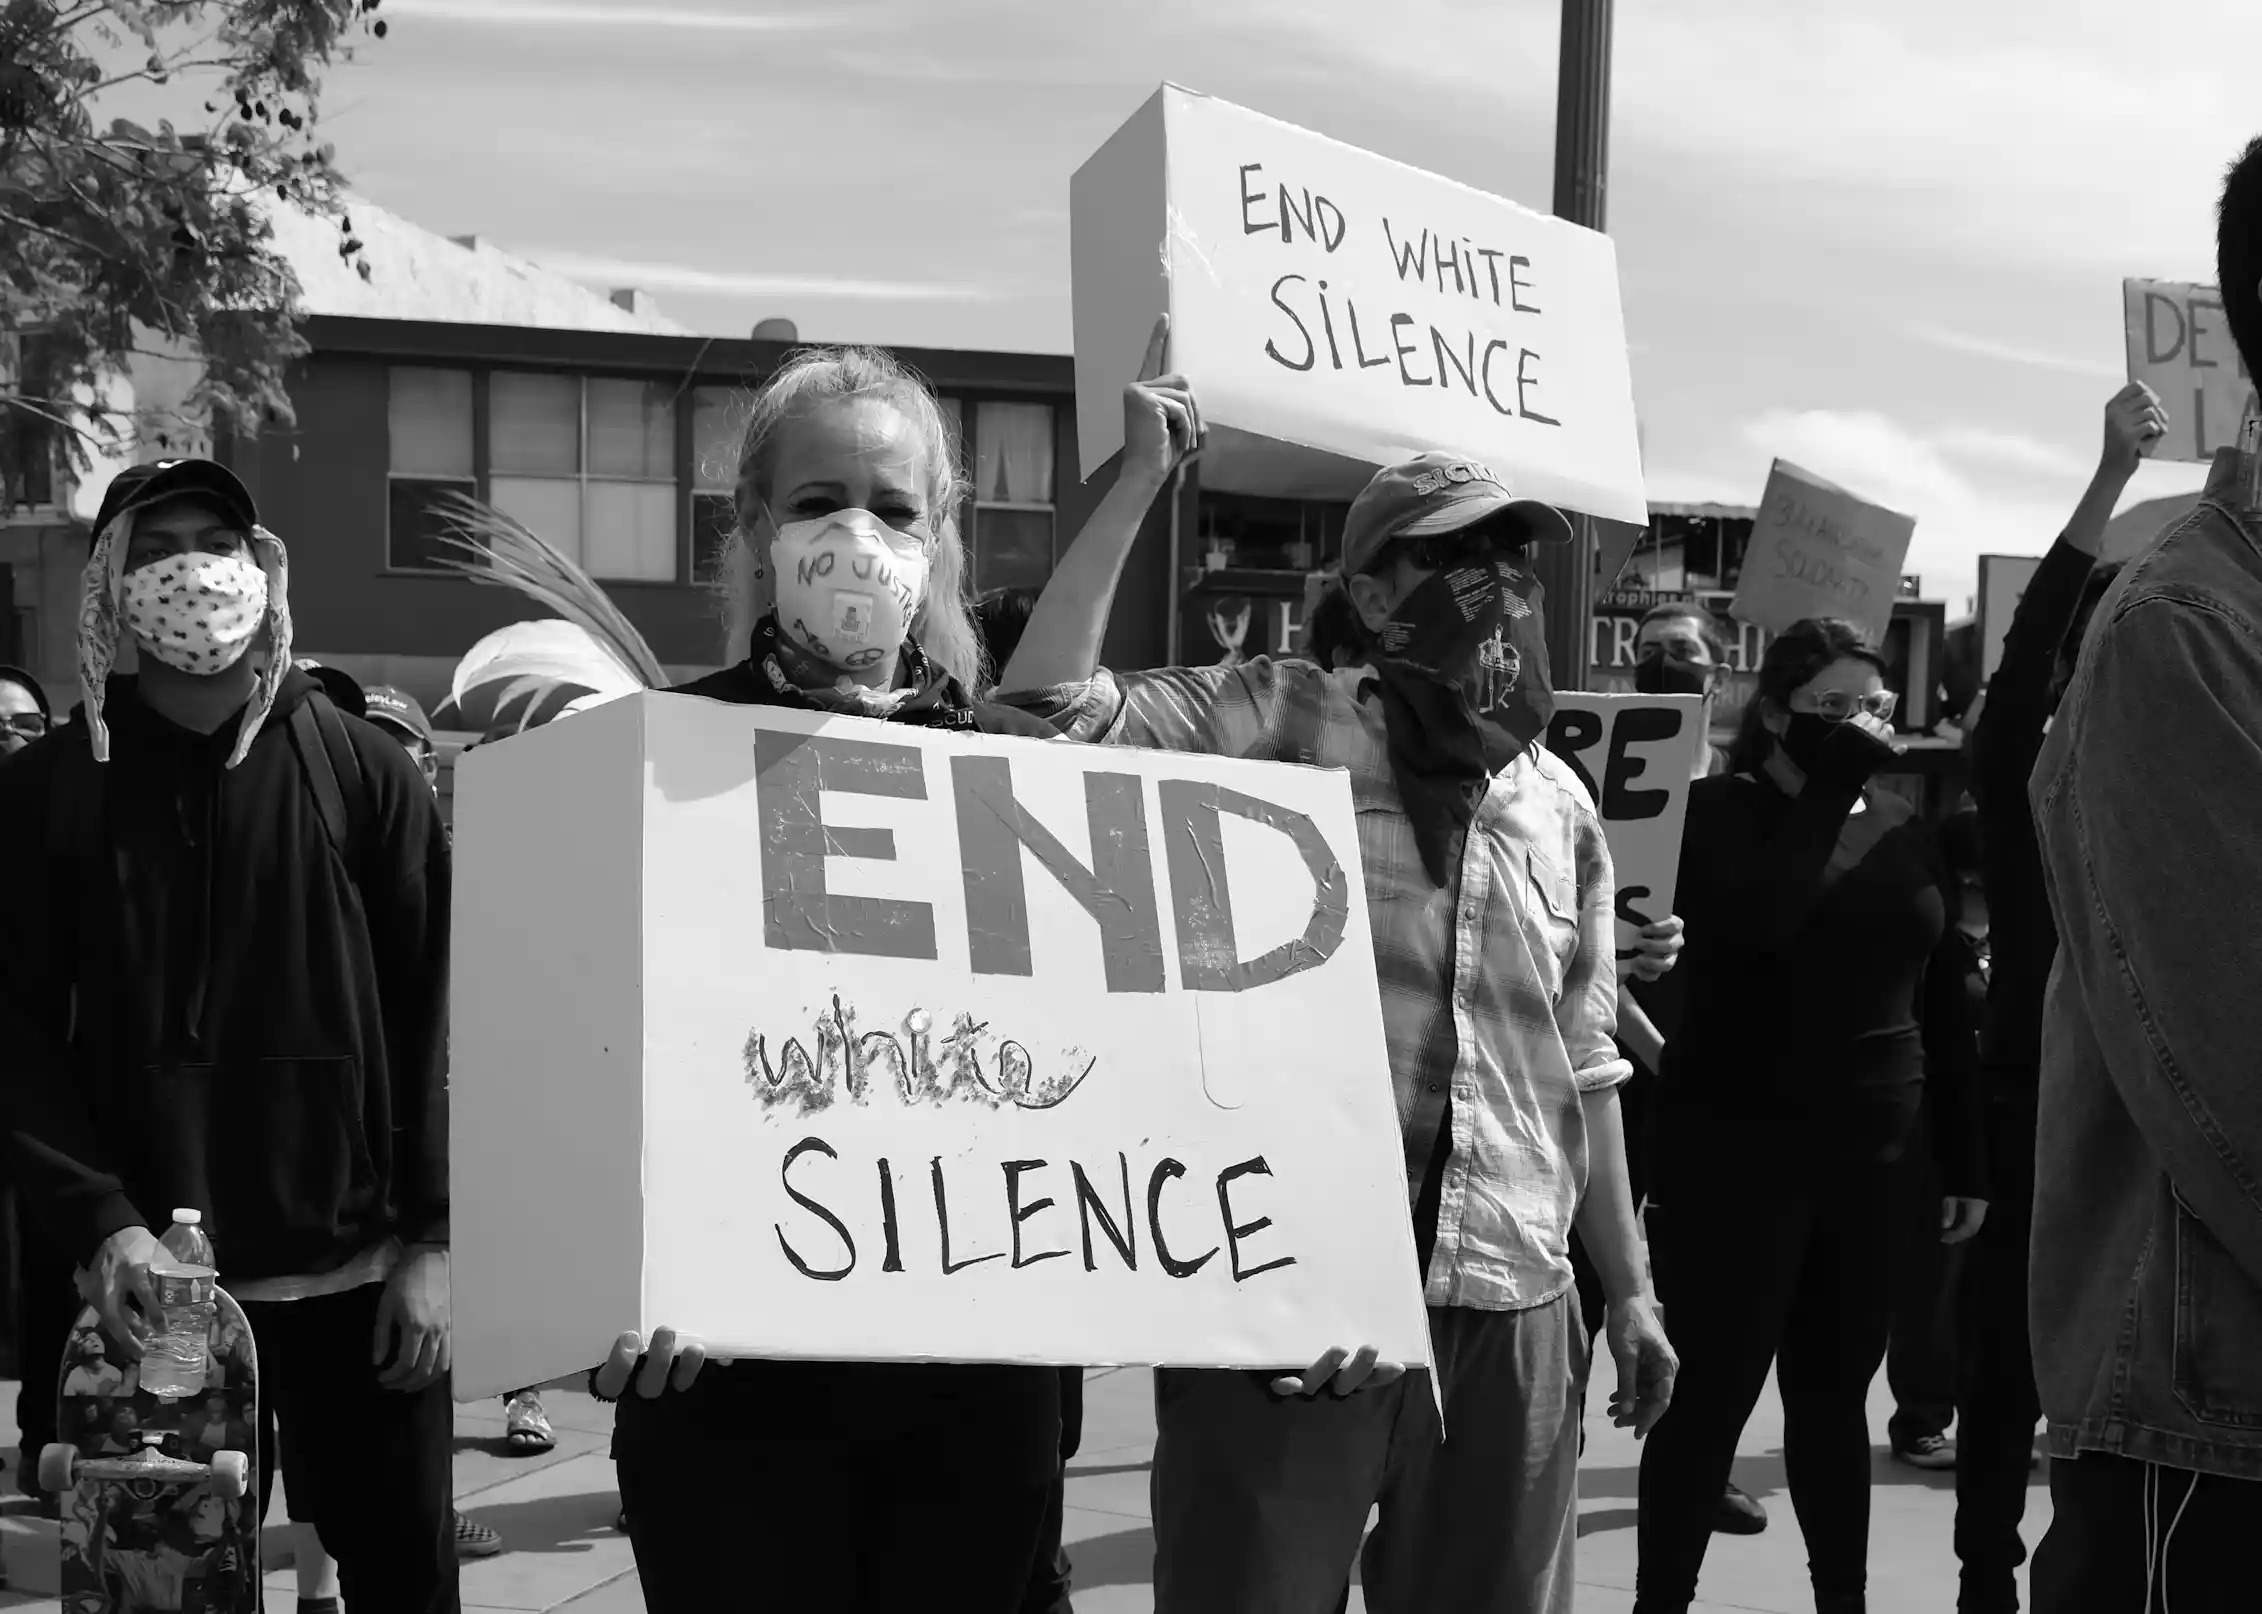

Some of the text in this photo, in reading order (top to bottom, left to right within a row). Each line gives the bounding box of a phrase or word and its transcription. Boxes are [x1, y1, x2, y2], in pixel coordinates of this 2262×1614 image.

[1239, 162, 1347, 253] END
[797, 550, 836, 588] NO
[753, 728, 1349, 994] END
[745, 993, 1097, 1114] white
[774, 1136, 1298, 1282] SILENCE
